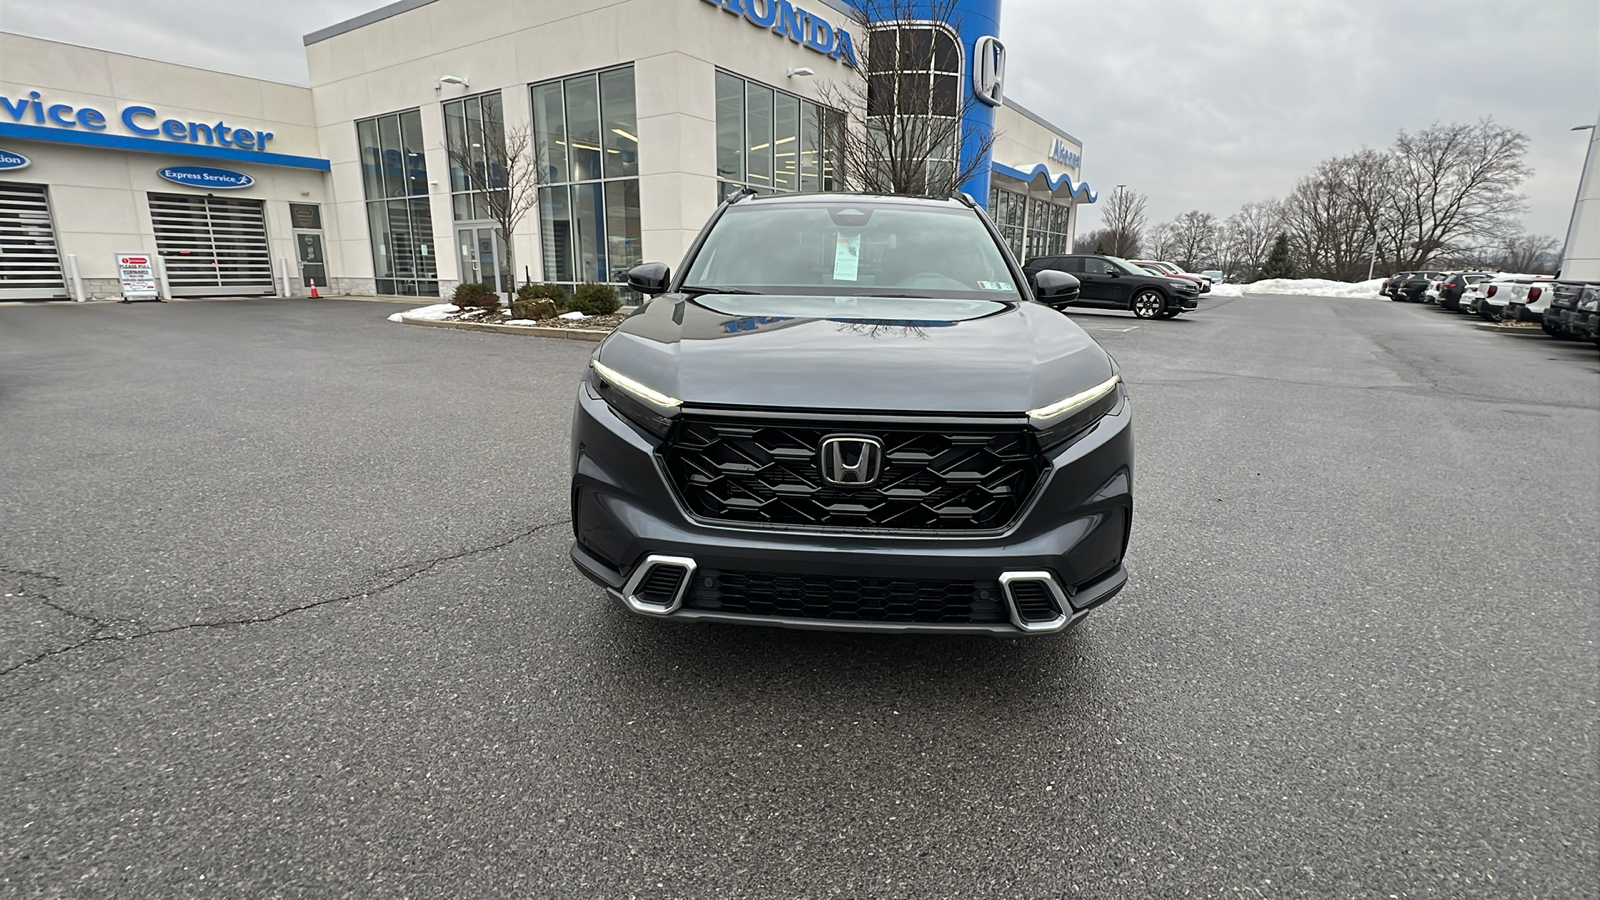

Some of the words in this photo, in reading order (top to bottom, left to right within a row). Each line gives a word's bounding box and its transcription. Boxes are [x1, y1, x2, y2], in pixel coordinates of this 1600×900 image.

[121, 105, 273, 150] Center
[164, 169, 202, 179] Express
[203, 172, 237, 183] Service
